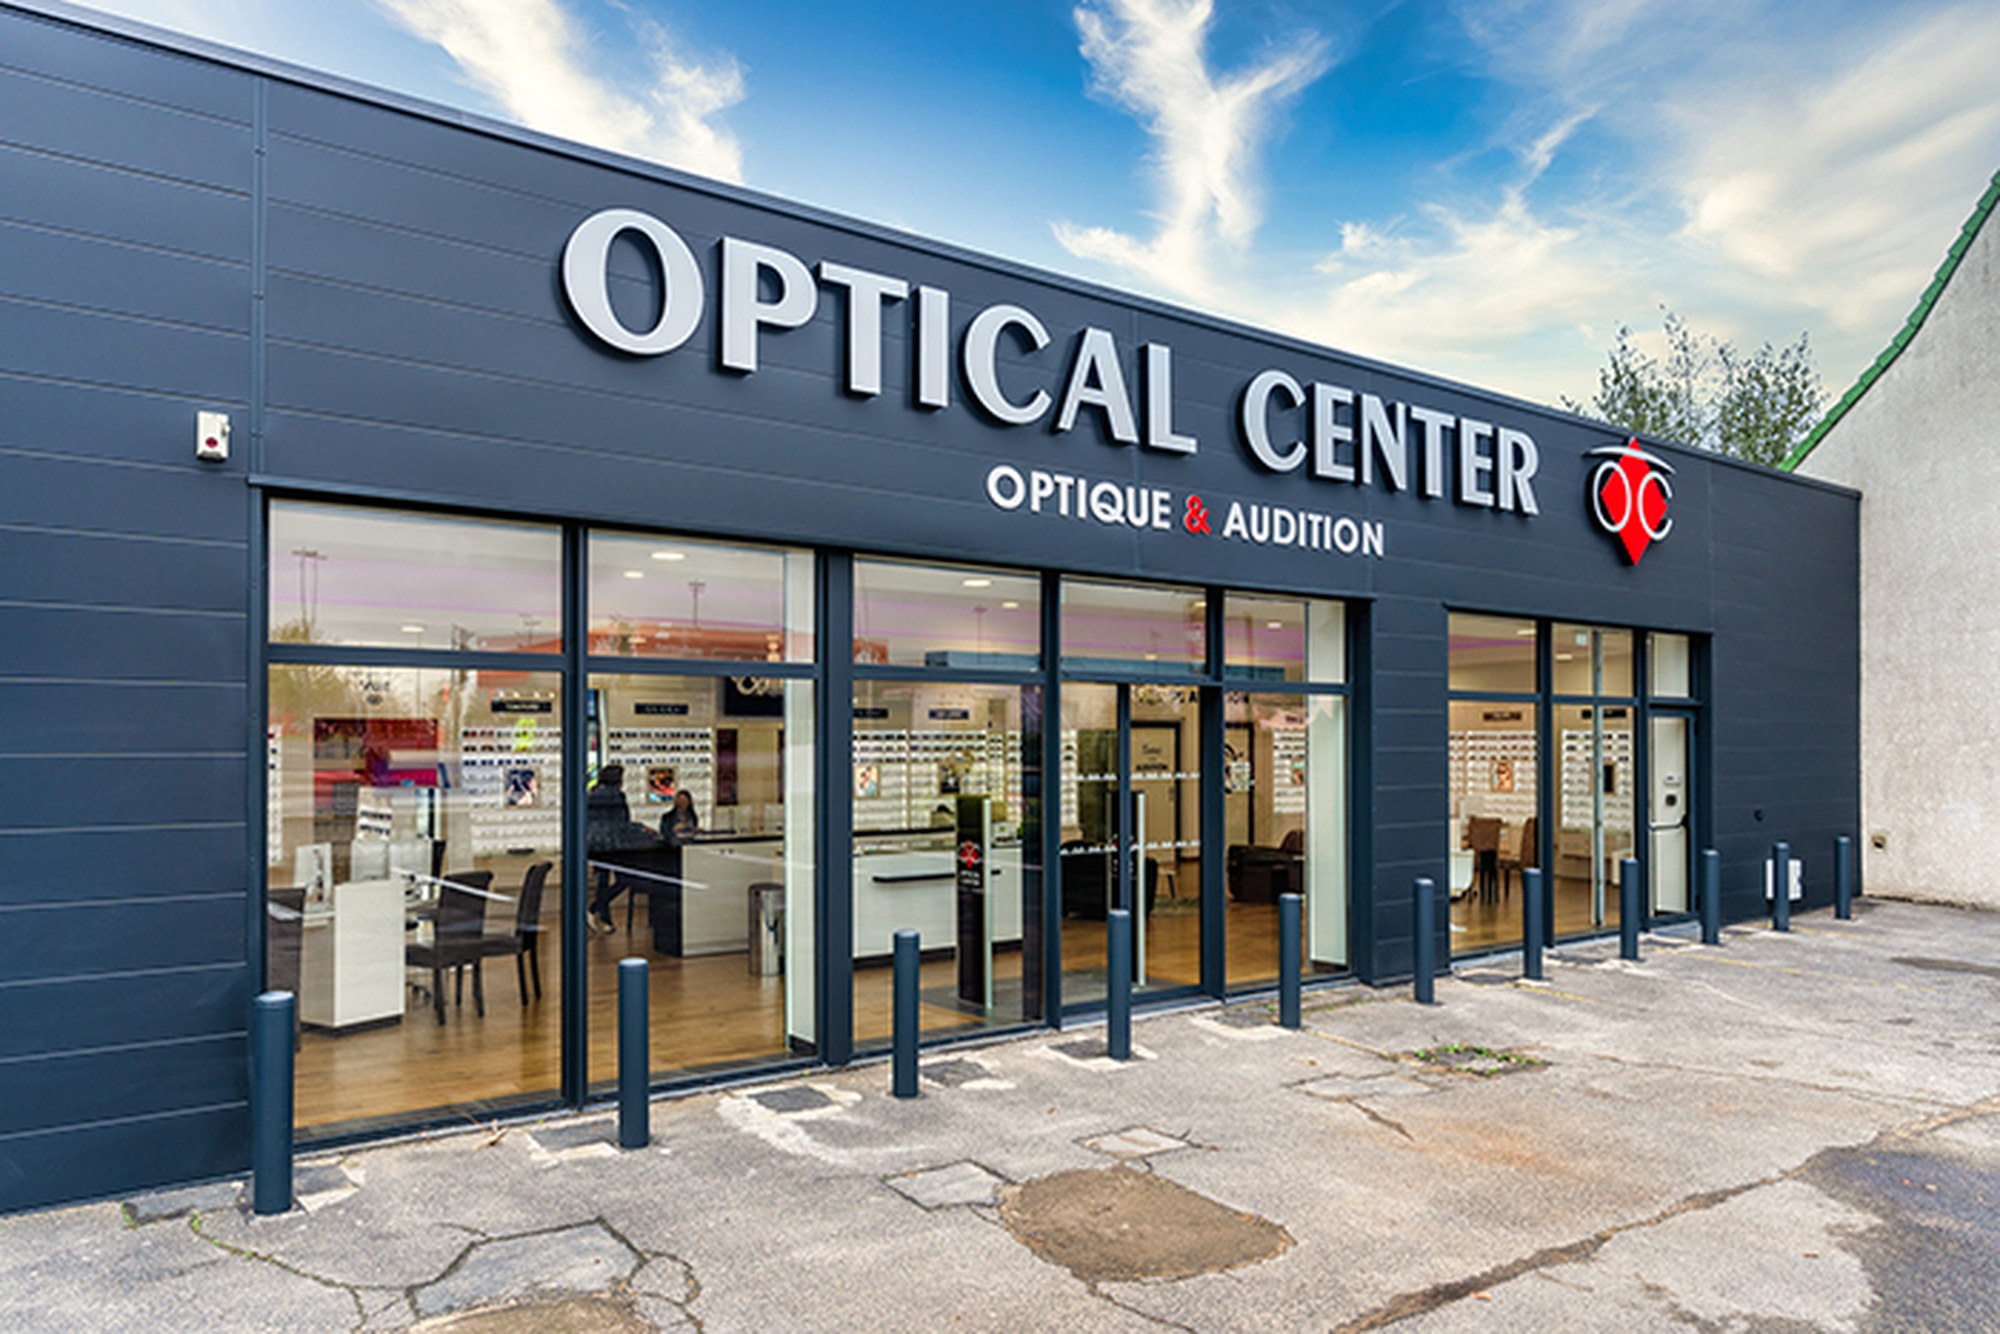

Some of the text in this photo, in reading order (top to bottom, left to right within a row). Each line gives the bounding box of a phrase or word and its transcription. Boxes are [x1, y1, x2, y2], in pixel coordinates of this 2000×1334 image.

[563, 208, 1540, 516] OPTICAL CENTER
[987, 465, 1385, 557] OPTIQUE & AUDITION
